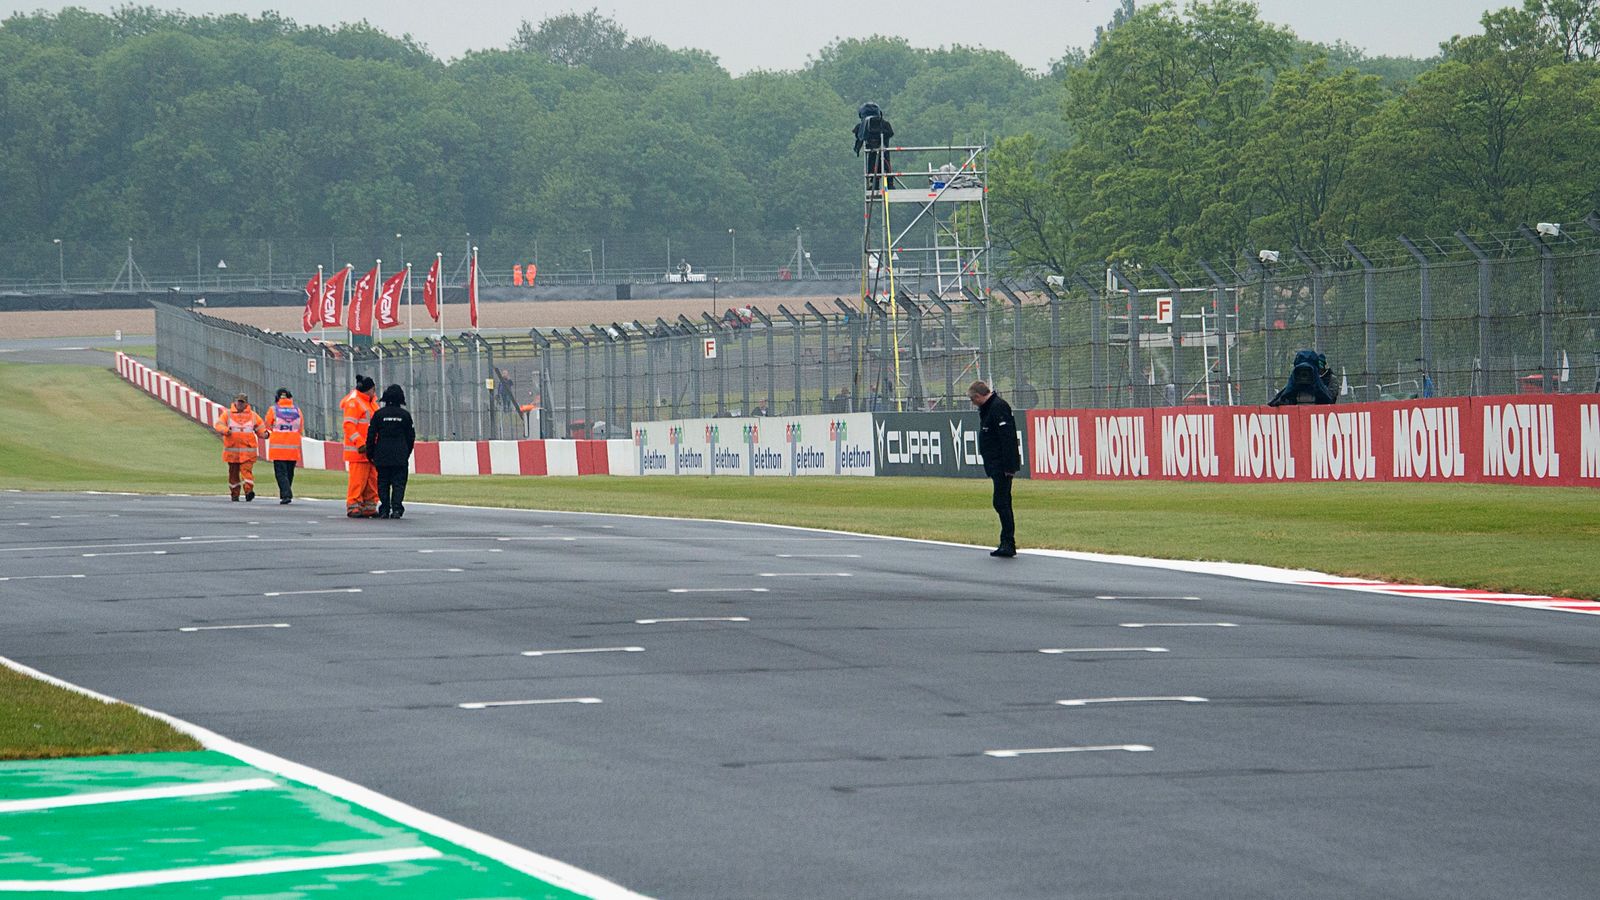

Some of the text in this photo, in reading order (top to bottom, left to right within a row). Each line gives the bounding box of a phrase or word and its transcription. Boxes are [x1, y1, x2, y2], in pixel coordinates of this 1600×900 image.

[1159, 301, 1171, 321] F
[706, 341, 715, 356] F
[887, 431, 942, 464] CUPRA
[1034, 416, 1083, 475] MOTUL
[1095, 416, 1149, 477] MOTUL
[1161, 414, 1219, 477] MOTUL
[1233, 413, 1295, 479] MOTUL
[1311, 412, 1376, 480] MOTUL
[1393, 407, 1465, 478] MOTUL
[1484, 403, 1560, 478] MOTUL
